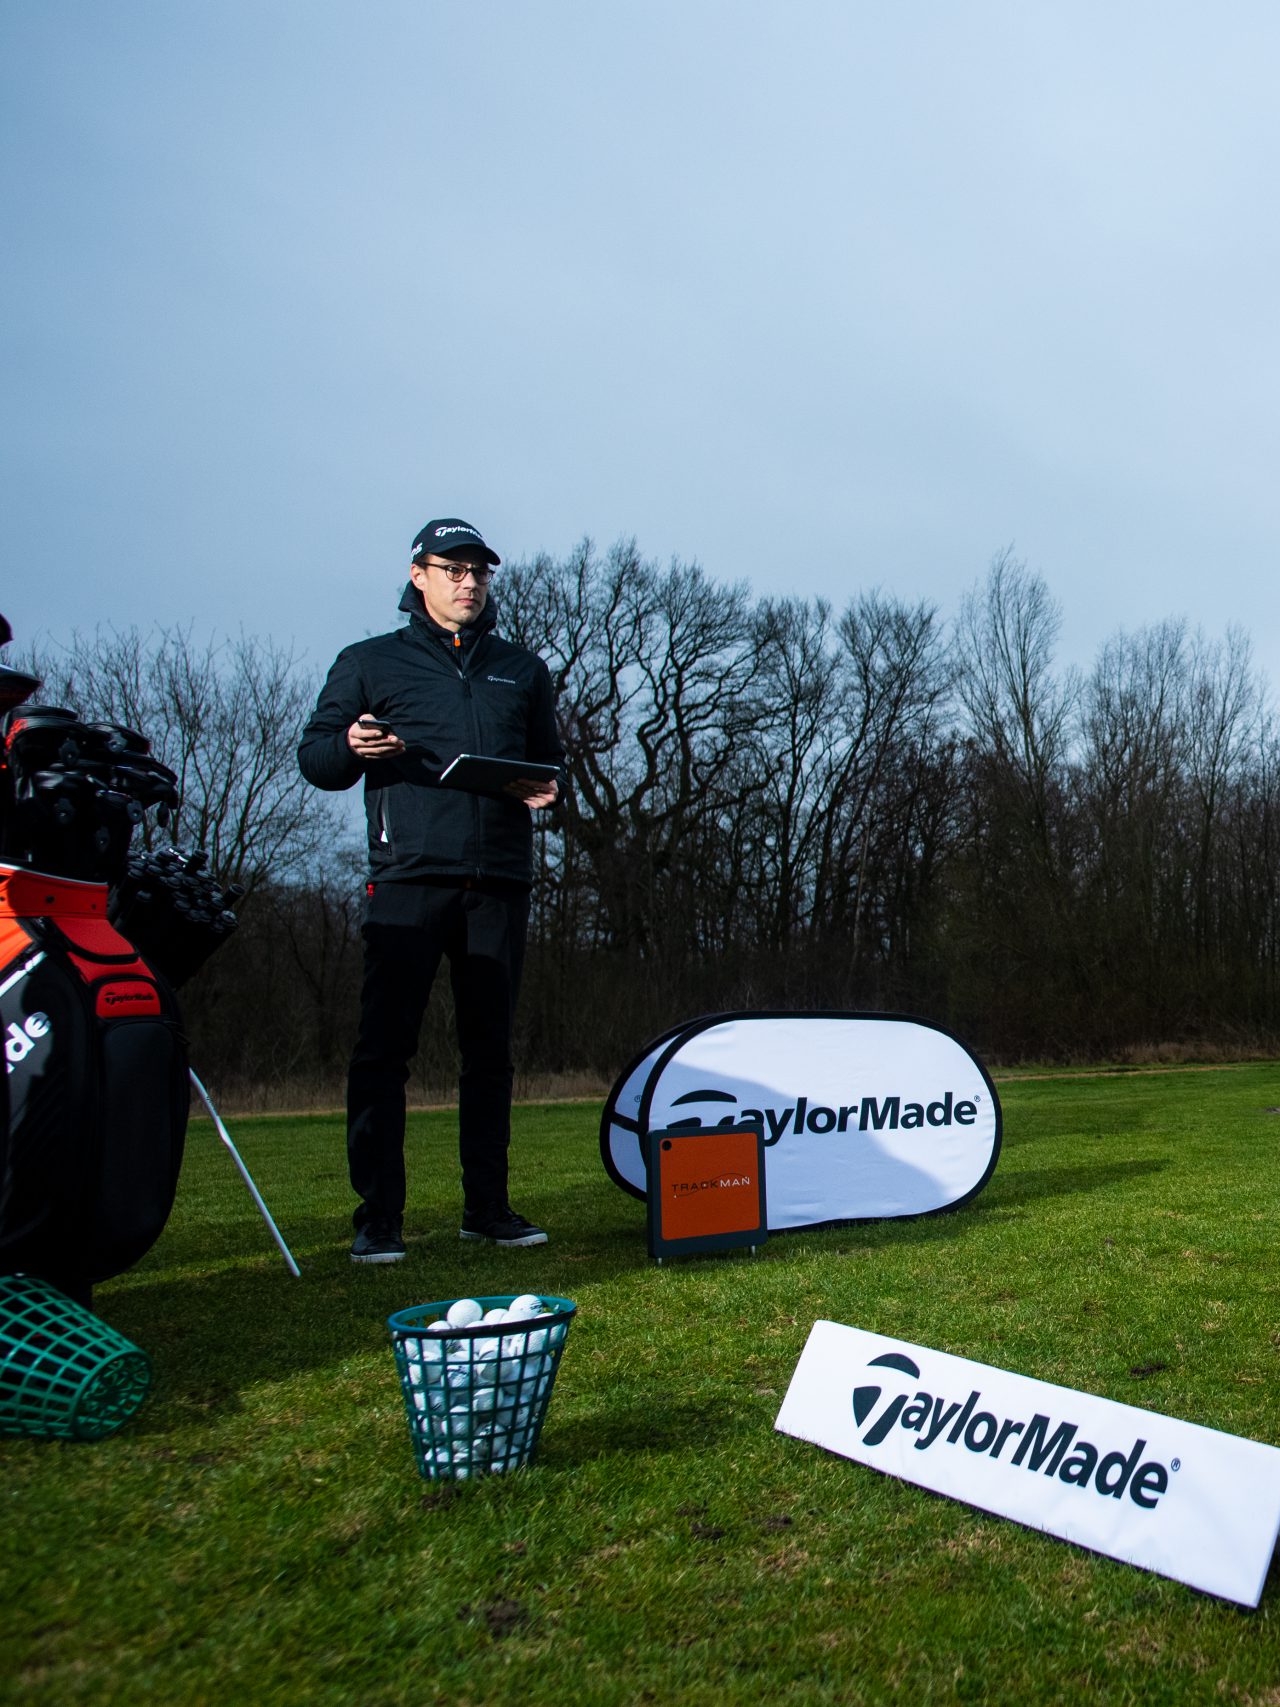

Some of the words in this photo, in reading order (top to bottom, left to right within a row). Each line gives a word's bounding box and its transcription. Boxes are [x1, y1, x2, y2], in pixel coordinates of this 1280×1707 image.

[5, 1011, 51, 1074] de
[672, 1176, 750, 1193] TRACKMAN
[853, 1352, 1169, 1509] TaylorMade
